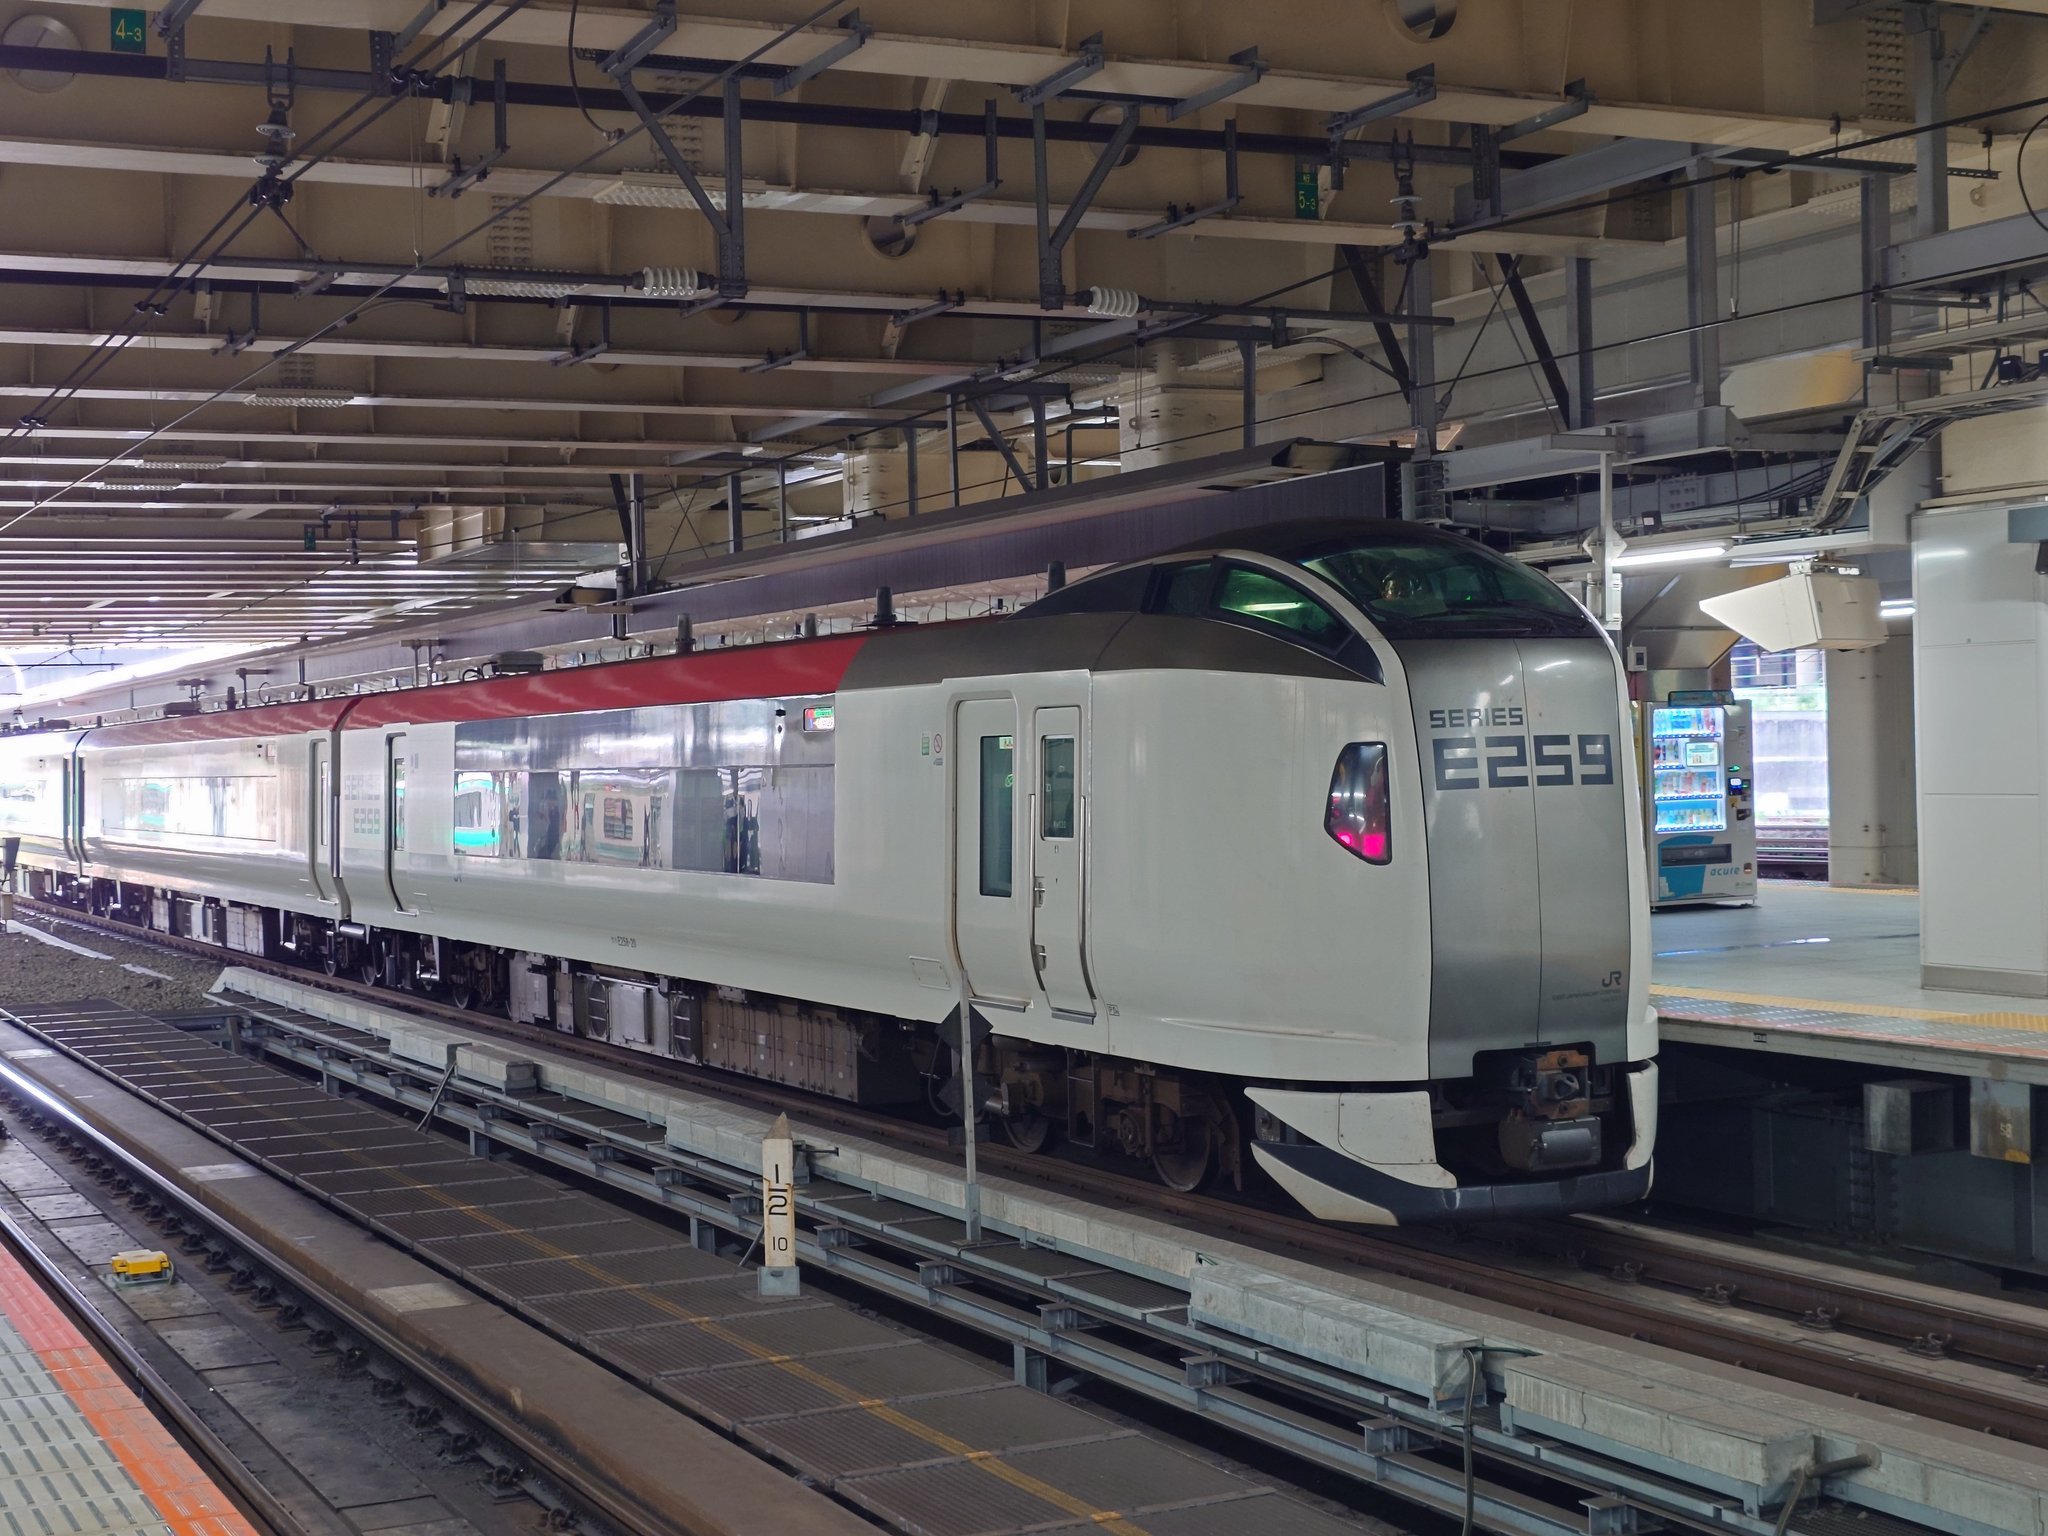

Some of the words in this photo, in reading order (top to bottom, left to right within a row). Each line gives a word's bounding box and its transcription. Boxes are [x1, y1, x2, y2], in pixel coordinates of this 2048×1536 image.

[115, 17, 142, 42] 4-3
[1298, 190, 1316, 210] 5-3
[1429, 707, 1524, 728] SERIES
[1432, 734, 1614, 790] E259
[1710, 866, 1740, 876] acure
[1602, 970, 1622, 987] JR
[768, 1195, 788, 1216] 2
[772, 1236, 788, 1252] 10
